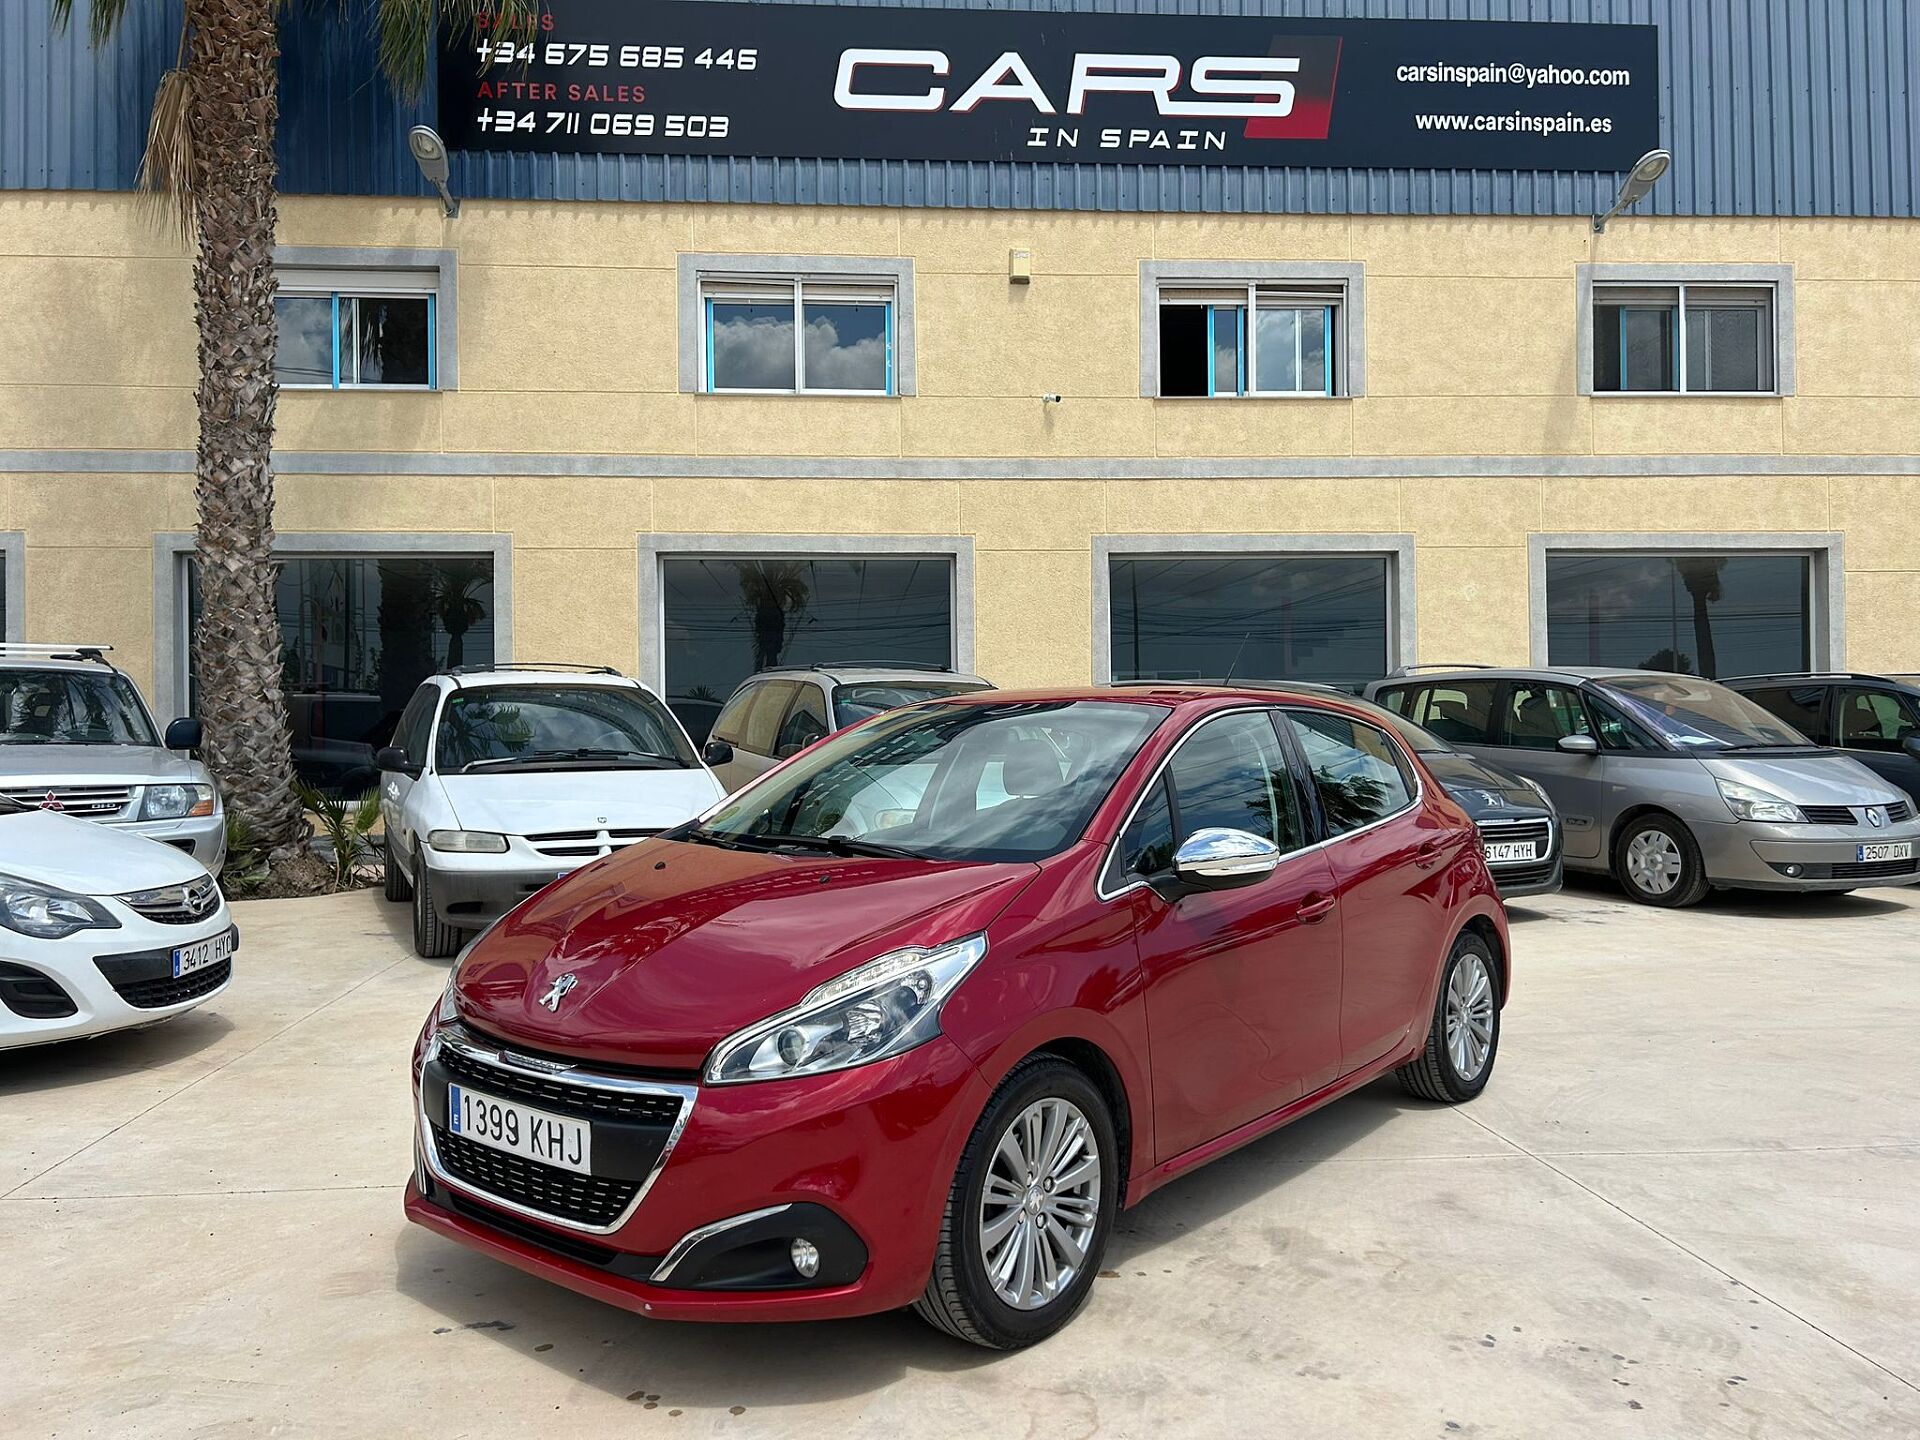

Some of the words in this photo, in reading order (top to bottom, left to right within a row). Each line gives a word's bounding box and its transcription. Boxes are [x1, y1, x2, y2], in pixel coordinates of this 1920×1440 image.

[476, 38, 536, 64] +34
[544, 43, 610, 66] 675
[619, 45, 685, 69] 685
[694, 47, 758, 71] 446
[833, 48, 1300, 117] CARS
[1396, 61, 1631, 88] carsinspain@yahoo.com
[477, 81, 557, 100] AFTER
[568, 84, 646, 103] SALES
[477, 107, 536, 133] +34
[545, 112, 580, 134] 711
[590, 113, 655, 136] 069
[664, 115, 730, 138] 503
[1415, 110, 1613, 136] www.carsinspain.es
[1027, 127, 1080, 148] IN
[1099, 128, 1227, 151] SPAIN
[1485, 845, 1511, 859] 6147
[1513, 844, 1533, 858] HYH
[1865, 845, 1889, 860] 2507
[183, 943, 209, 971] 3412
[464, 1095, 520, 1146] 1399
[530, 1115, 582, 1165] KHJ
